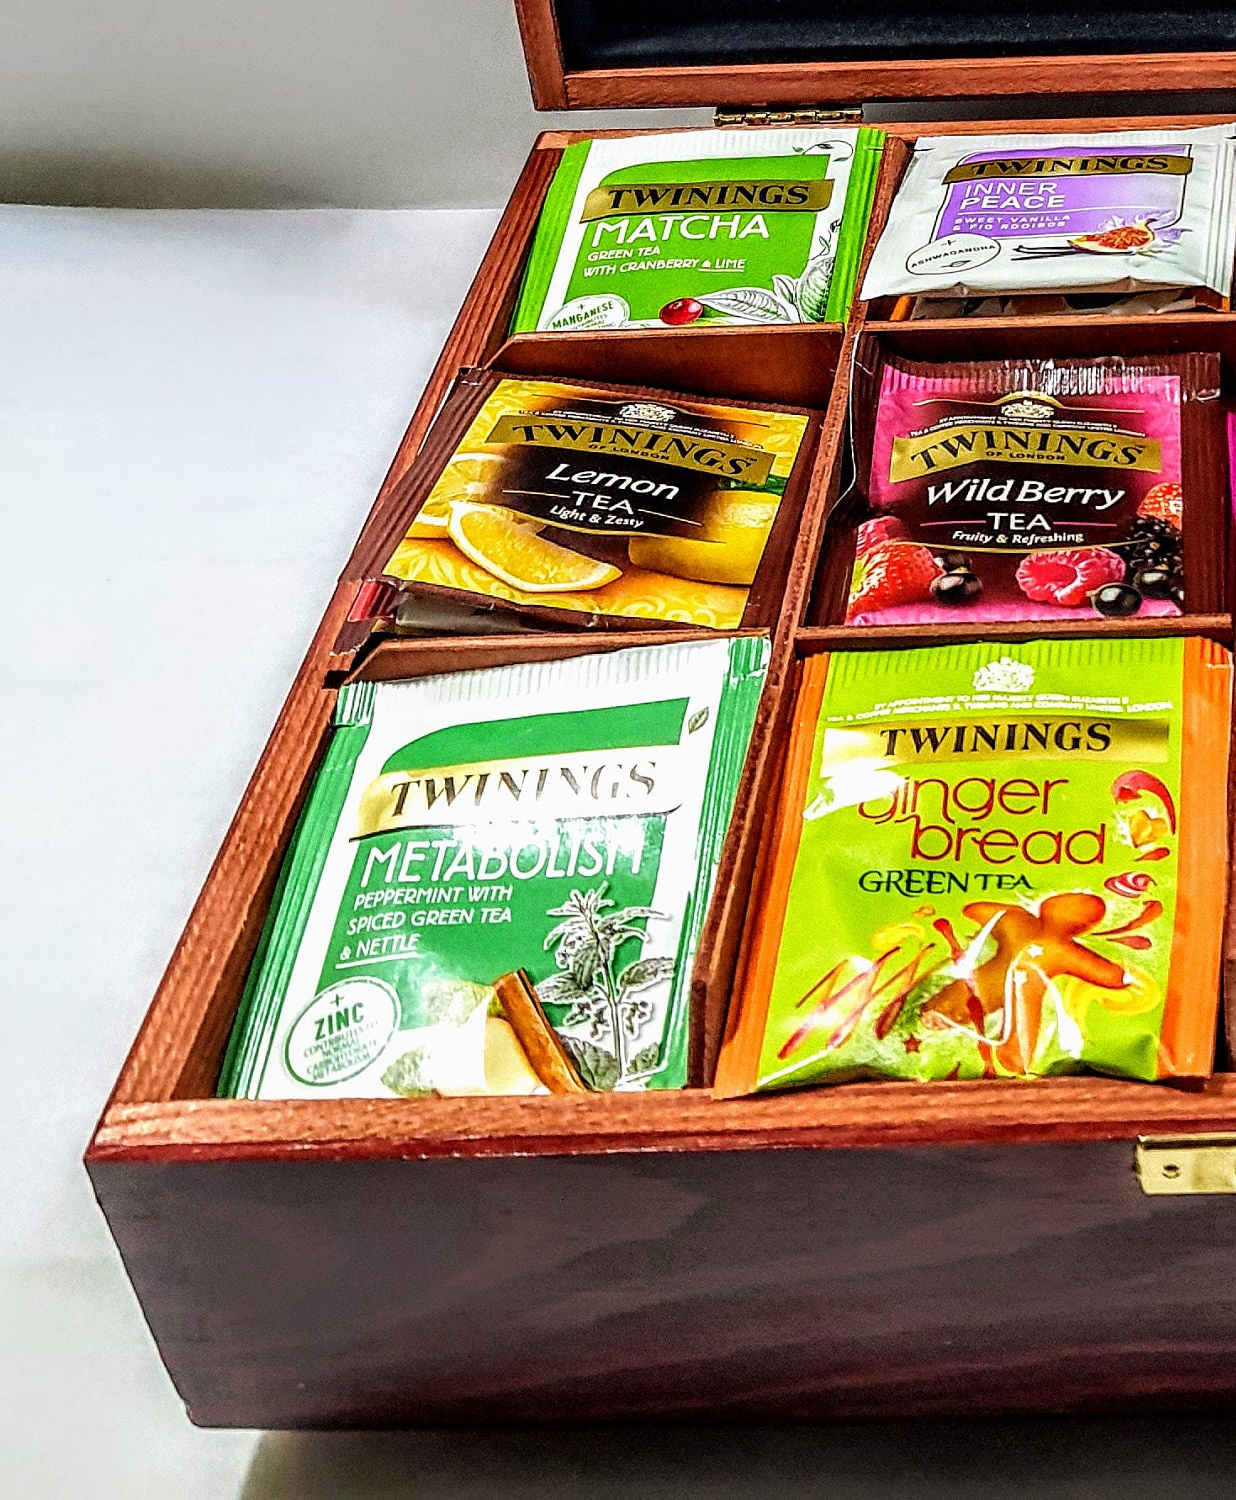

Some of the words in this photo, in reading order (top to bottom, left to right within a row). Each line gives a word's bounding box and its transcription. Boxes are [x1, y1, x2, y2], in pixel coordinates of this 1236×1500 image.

[972, 156, 1170, 176] TWININGS
[608, 184, 810, 211] TWININGS
[960, 195, 1066, 210] PEACE
[964, 182, 1058, 198] INNER
[591, 213, 770, 248] MATCHA
[1010, 215, 1070, 223] VANILLA
[587, 248, 634, 262] GREEN
[637, 245, 661, 258] TEA
[583, 264, 616, 278] WITH
[619, 258, 700, 274] CRANBERRY
[715, 258, 746, 269] LIME
[552, 301, 614, 330] MANGANESE
[513, 424, 754, 475] TWININGS
[588, 443, 606, 451] OF
[910, 430, 1144, 470] TWININGS
[1009, 452, 1066, 461] LONDON
[545, 463, 680, 500] Lemon
[926, 478, 1015, 506] Wild
[1019, 481, 1125, 511] Berry
[572, 490, 635, 515] TEA
[549, 505, 585, 522] Light
[588, 512, 602, 524] &
[605, 513, 644, 529] Zesty
[987, 512, 1051, 531] TEA
[952, 530, 994, 544] Fruity
[996, 534, 1008, 544] &
[1011, 531, 1085, 546] Refreshing
[880, 722, 1112, 757] TWININGS
[894, 814, 1107, 867] bread
[858, 869, 970, 898] GREEN
[974, 871, 1035, 892] TEA
[353, 886, 466, 911] PEPPERMINT
[468, 884, 513, 903] WITH
[346, 913, 407, 937] SPICED
[410, 910, 475, 928] GREEN
[480, 906, 512, 924] TEA
[339, 945, 351, 960] &
[355, 932, 421, 959] NETTLE
[314, 1002, 364, 1041] ZINC
